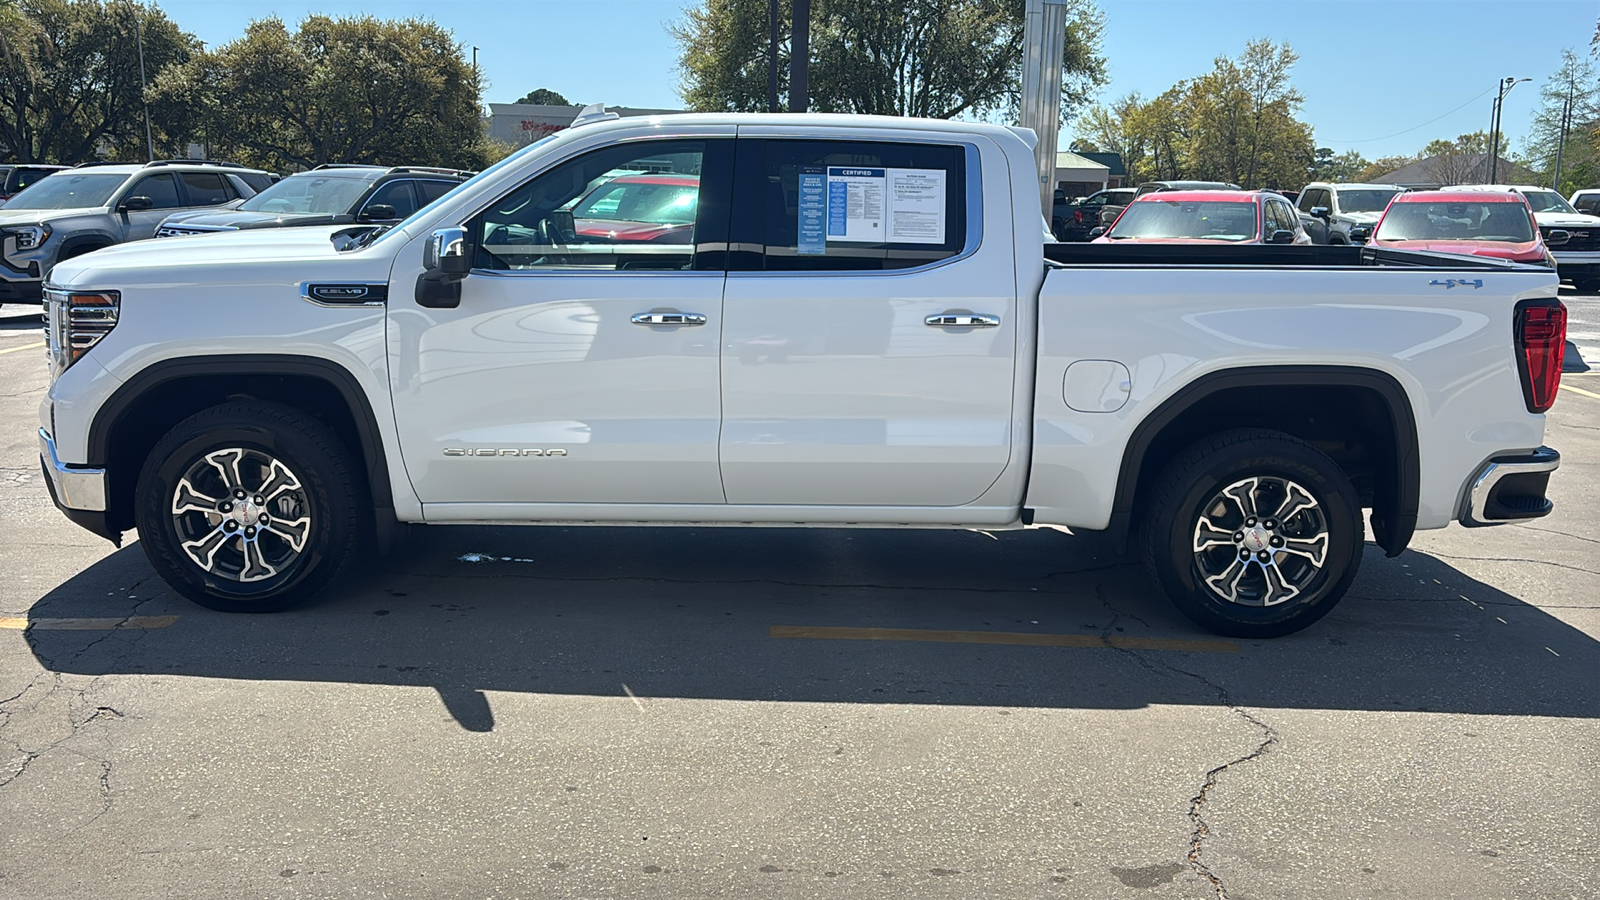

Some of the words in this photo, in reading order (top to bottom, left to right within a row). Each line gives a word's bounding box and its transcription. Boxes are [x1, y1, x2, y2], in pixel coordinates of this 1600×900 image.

[443, 448, 568, 457] SIERRA
[241, 503, 250, 523] GMC
[1251, 530, 1264, 548] GMC
